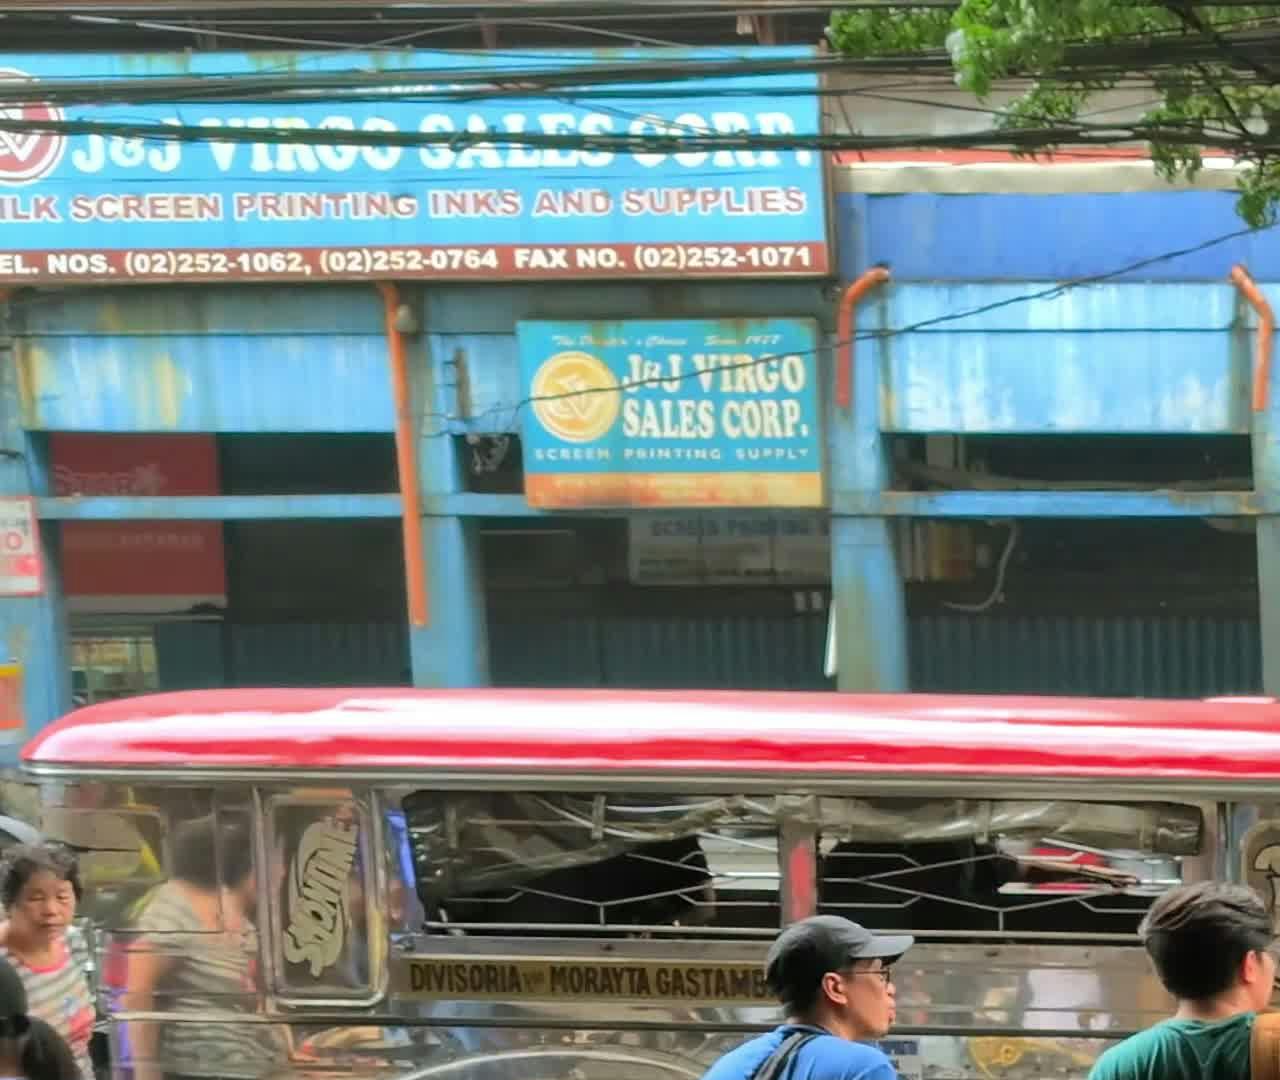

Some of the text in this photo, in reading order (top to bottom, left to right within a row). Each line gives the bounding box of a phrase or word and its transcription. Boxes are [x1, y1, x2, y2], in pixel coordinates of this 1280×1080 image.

[199, 115, 401, 173] VIRGO
[418, 113, 614, 169] SALES
[72, 195, 221, 220] SCREEN
[236, 194, 416, 219] PRINTING
[431, 192, 519, 215] INKS
[535, 191, 610, 214] AND
[625, 189, 805, 213] SUPPLIES
[48, 253, 116, 274] NOS.
[125, 251, 311, 275] (02)252-1062,
[320, 249, 497, 274] (02)252-0764
[514, 248, 567, 268] FAX
[577, 248, 625, 268] NO.
[634, 245, 811, 271] (02)252-1071
[692, 353, 805, 392] VIRGO
[622, 399, 808, 438] SALES CORP.
[535, 448, 810, 460] SCREEN PRINTING SUPPLY
[410, 963, 521, 994] DIVISORIA
[550, 965, 651, 995] MORAYTA
[655, 967, 770, 999] GASTAMB
